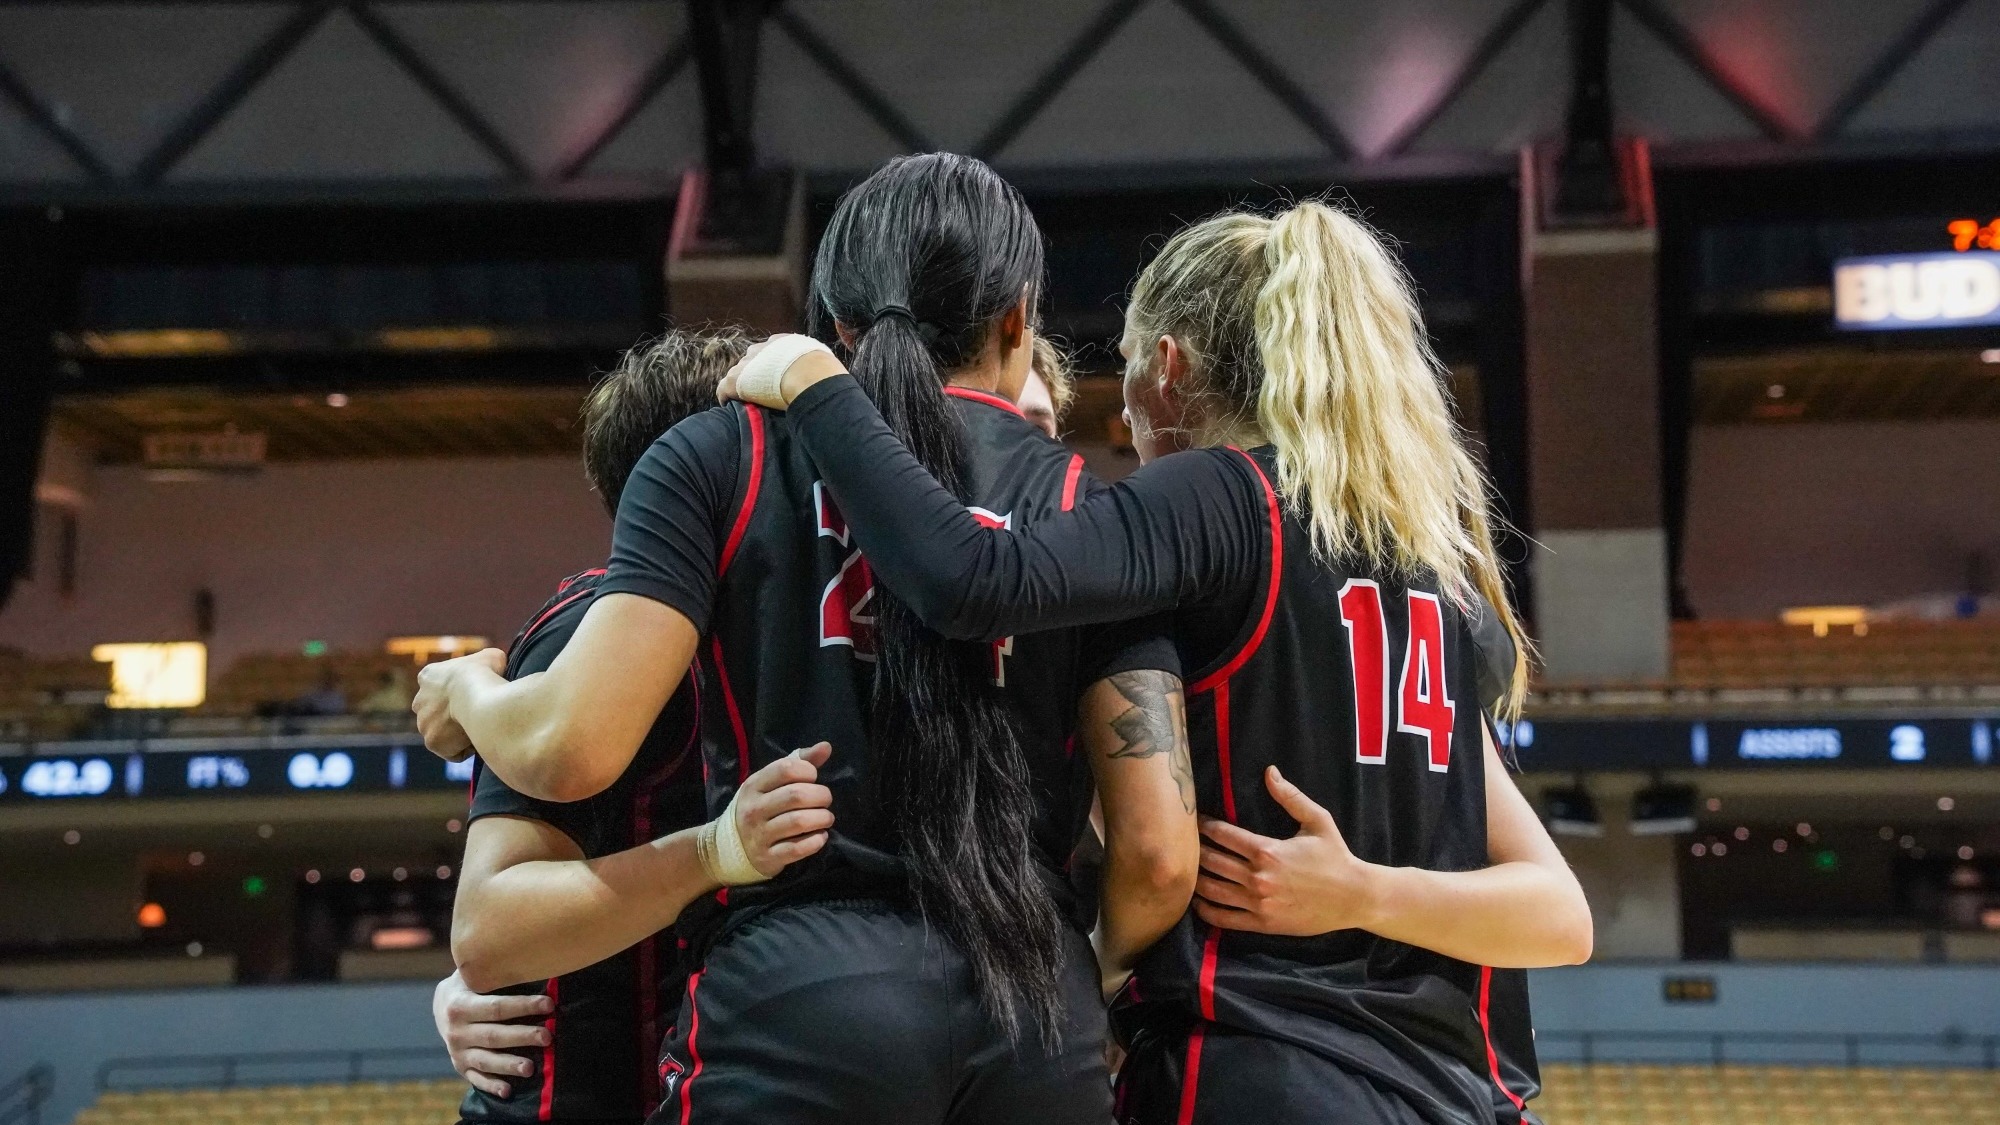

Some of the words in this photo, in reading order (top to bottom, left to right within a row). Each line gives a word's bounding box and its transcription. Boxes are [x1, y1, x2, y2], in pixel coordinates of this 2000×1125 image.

[1834, 259, 1999, 323] BUD
[813, 479, 1013, 687] 2
[1337, 577, 1455, 773] 14
[1739, 728, 1842, 759] ASSISTS
